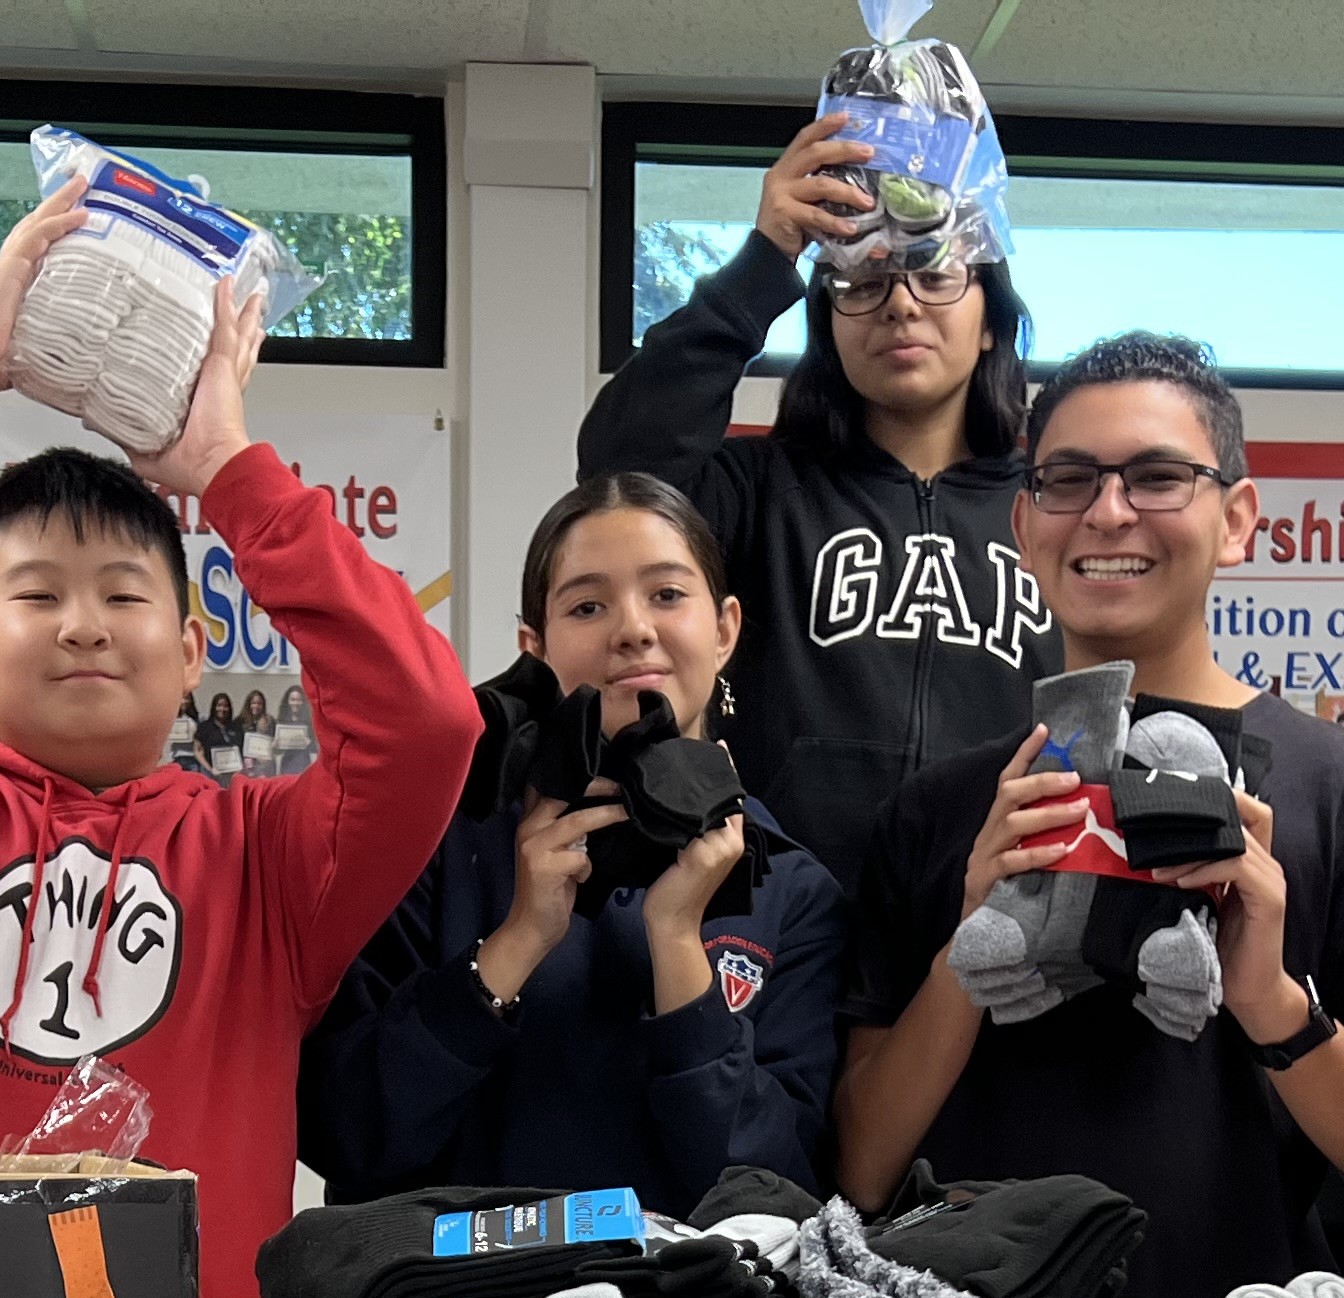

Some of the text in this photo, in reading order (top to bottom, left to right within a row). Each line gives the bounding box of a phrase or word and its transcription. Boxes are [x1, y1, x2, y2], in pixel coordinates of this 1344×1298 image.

[809, 527, 1053, 670] GAP
[1204, 595, 1312, 637] ition
[1236, 651, 1274, 690] &
[40, 960, 80, 1040] 1
